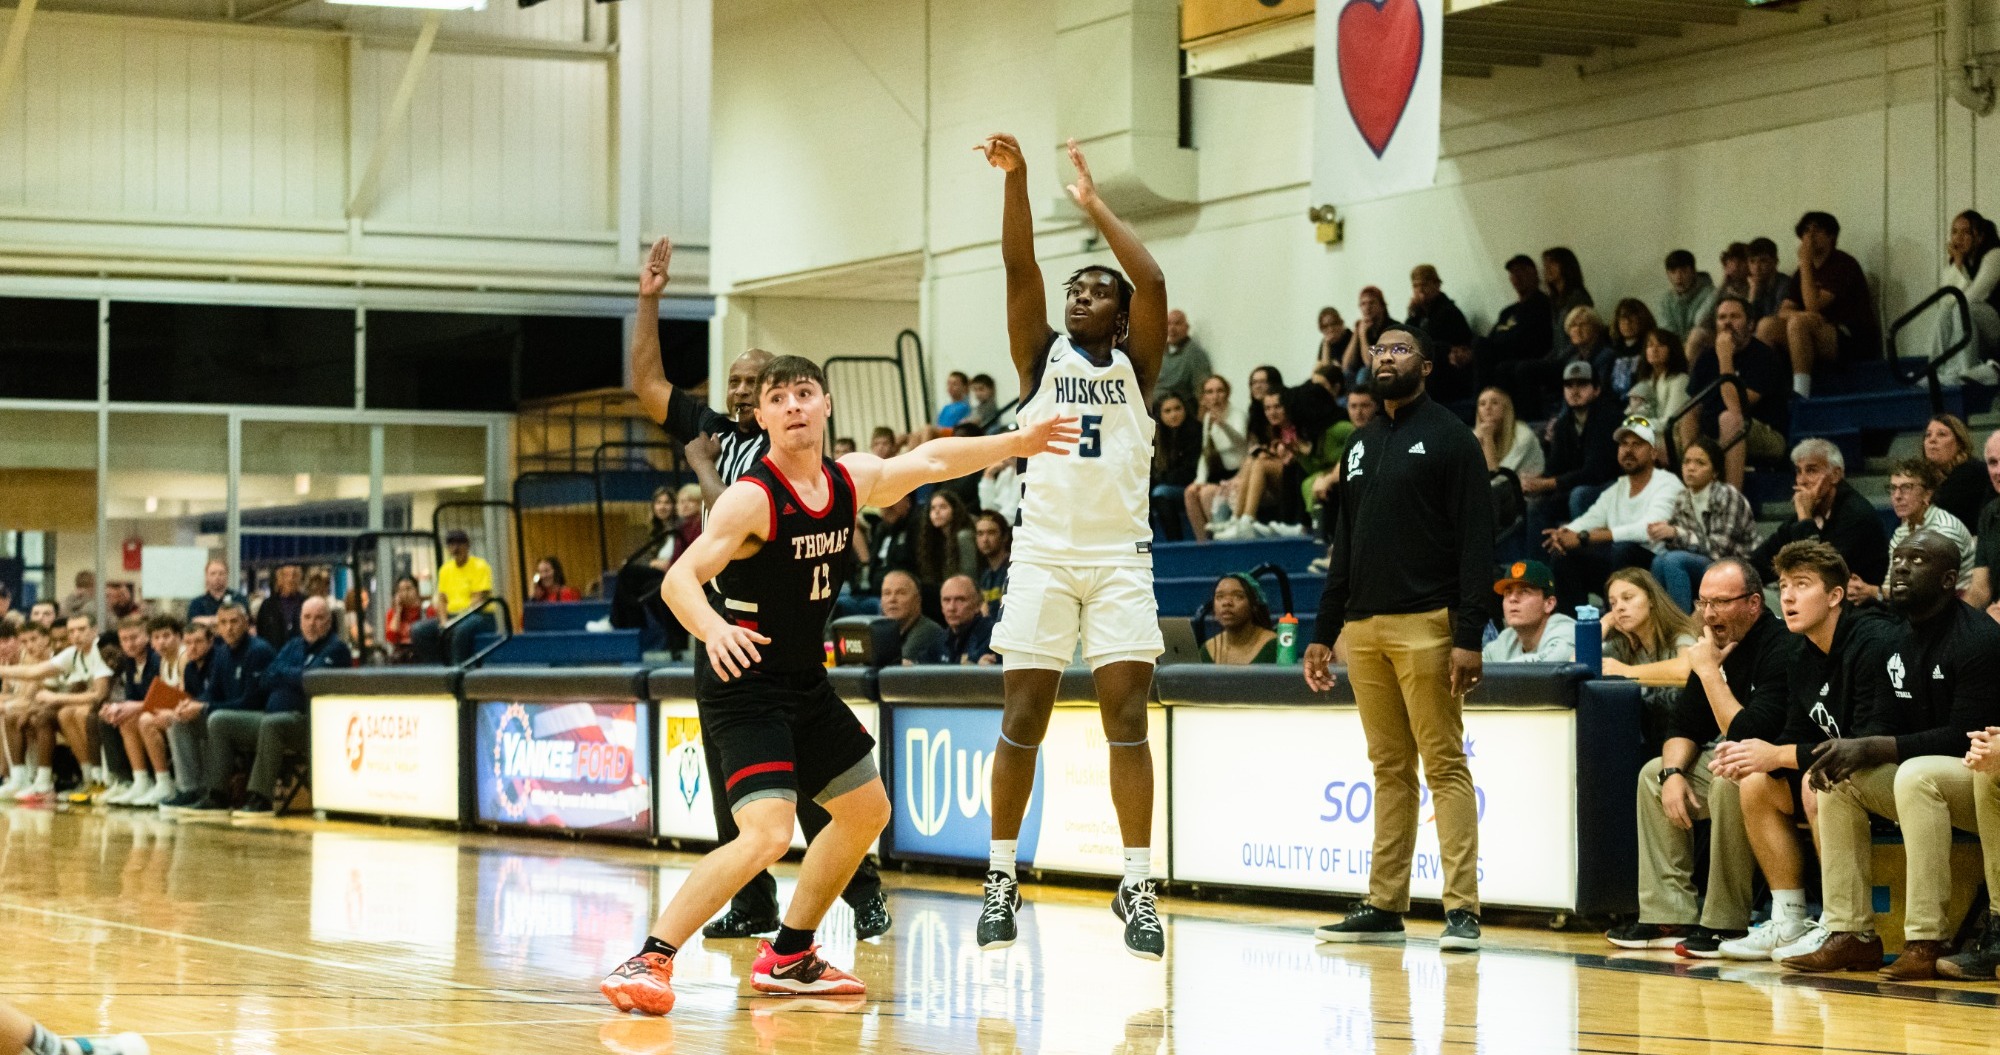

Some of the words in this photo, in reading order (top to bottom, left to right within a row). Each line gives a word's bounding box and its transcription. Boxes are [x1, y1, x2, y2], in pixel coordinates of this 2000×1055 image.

[1054, 376, 1127, 405] HUSKIES
[1079, 414, 1103, 458] 5
[791, 527, 850, 560] THOMAS
[1279, 631, 1294, 648] G
[503, 732, 576, 779] YANKEE
[576, 742, 629, 782] FORD
[1242, 842, 1314, 871] QUALITY
[1319, 847, 1342, 873] OF
[1348, 848, 1373, 875] LIF
